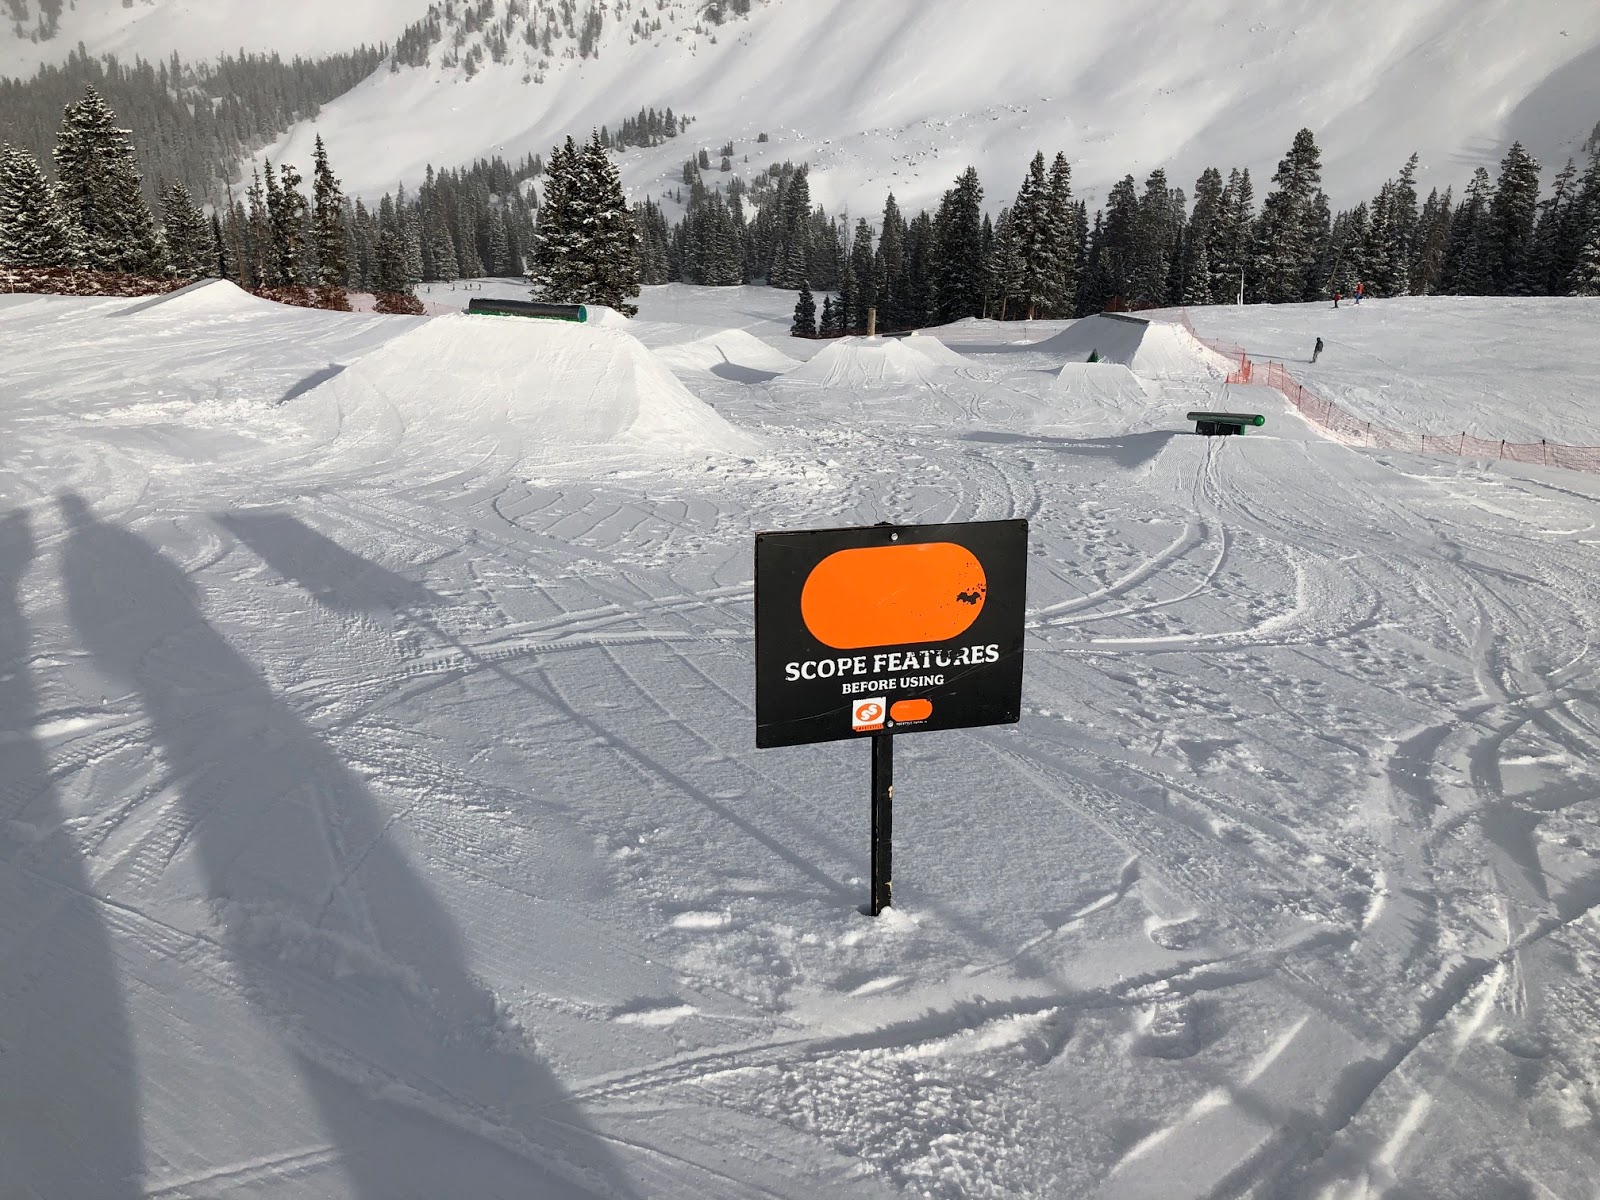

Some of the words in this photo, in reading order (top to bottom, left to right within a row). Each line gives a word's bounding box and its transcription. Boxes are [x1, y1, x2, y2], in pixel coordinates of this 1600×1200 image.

[785, 656, 867, 681] SCOPE
[873, 644, 1000, 673] FEATURES
[842, 678, 897, 694] BEFORE
[900, 674, 945, 688] USING
